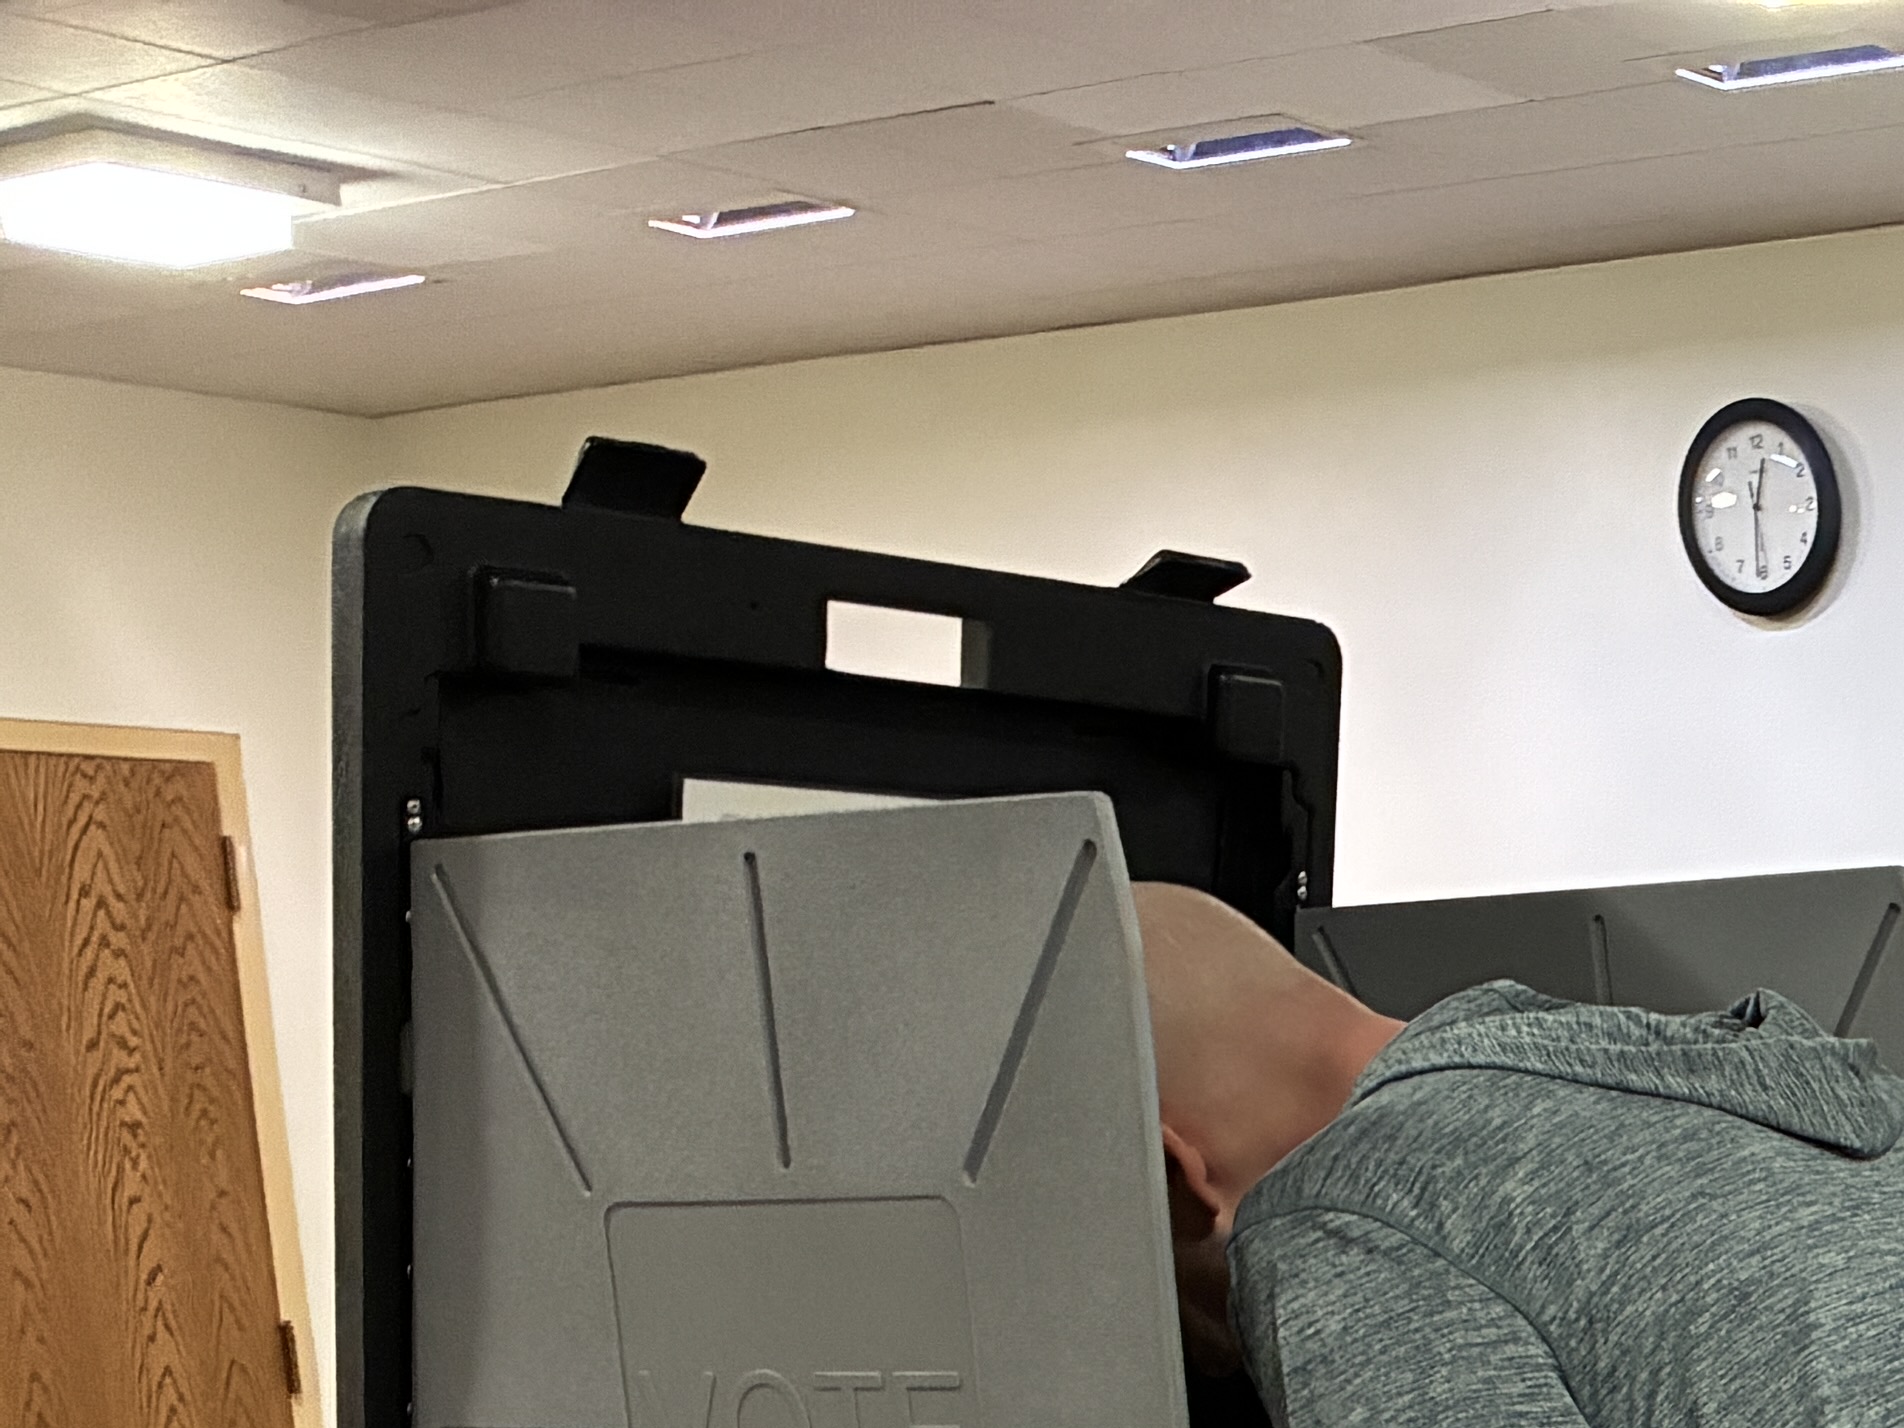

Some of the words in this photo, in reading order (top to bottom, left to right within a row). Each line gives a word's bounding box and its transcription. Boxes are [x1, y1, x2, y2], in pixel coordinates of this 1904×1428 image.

[1750, 433, 1764, 449] 12
[1727, 447, 1738, 459] 11
[1796, 461, 1806, 478] 2
[1800, 531, 1808, 546] 4
[1736, 559, 1745, 574] 7
[1783, 555, 1792, 571] 5
